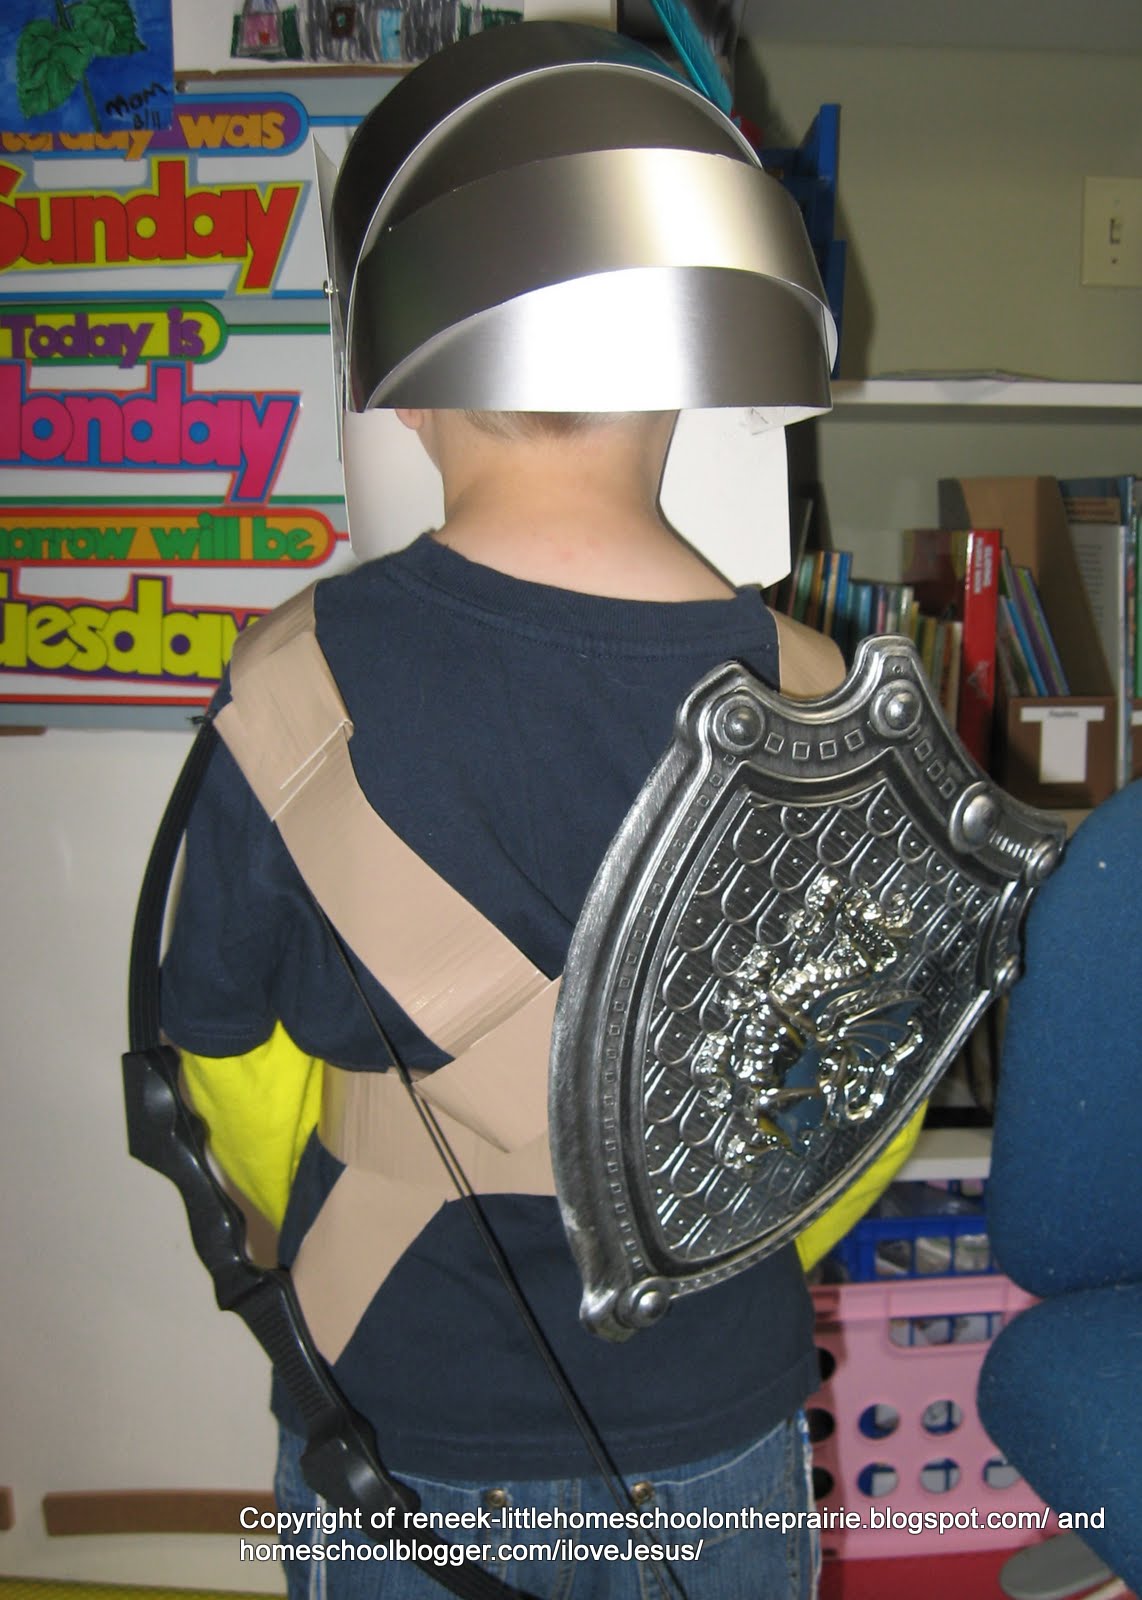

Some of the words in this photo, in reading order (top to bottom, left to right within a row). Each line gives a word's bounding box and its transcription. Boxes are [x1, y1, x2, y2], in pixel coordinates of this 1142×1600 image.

[179, 111, 286, 149] was
[0, 312, 154, 369] Today
[166, 306, 205, 357] is
[152, 512, 241, 561] will
[252, 516, 314, 560] be
